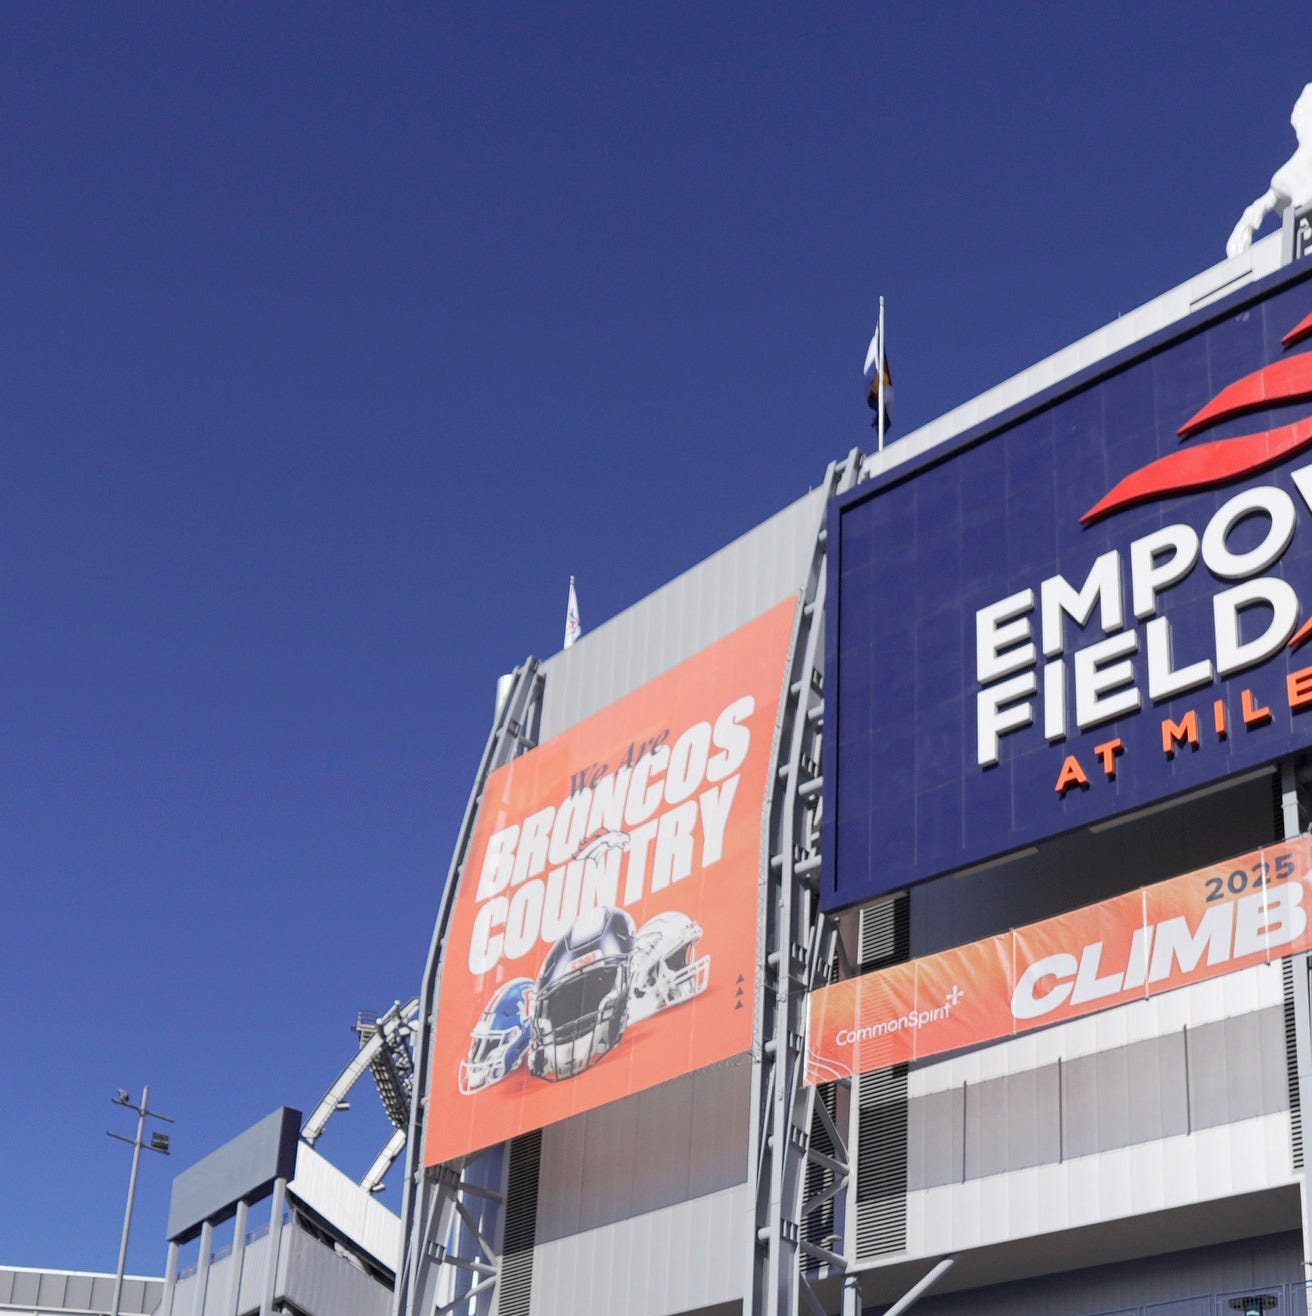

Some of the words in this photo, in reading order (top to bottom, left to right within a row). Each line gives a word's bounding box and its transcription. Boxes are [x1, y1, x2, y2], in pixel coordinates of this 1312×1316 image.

[977, 577, 1300, 768] FIELD
[475, 695, 755, 903] BRONCOS
[570, 762, 608, 800] We
[613, 729, 670, 781] Are
[1055, 738, 1123, 795] AT
[468, 774, 741, 976] COUNTRY
[1205, 853, 1295, 903] 2025
[1009, 879, 1307, 1020] CLIMB
[835, 1003, 951, 1046] CommonSpirit
